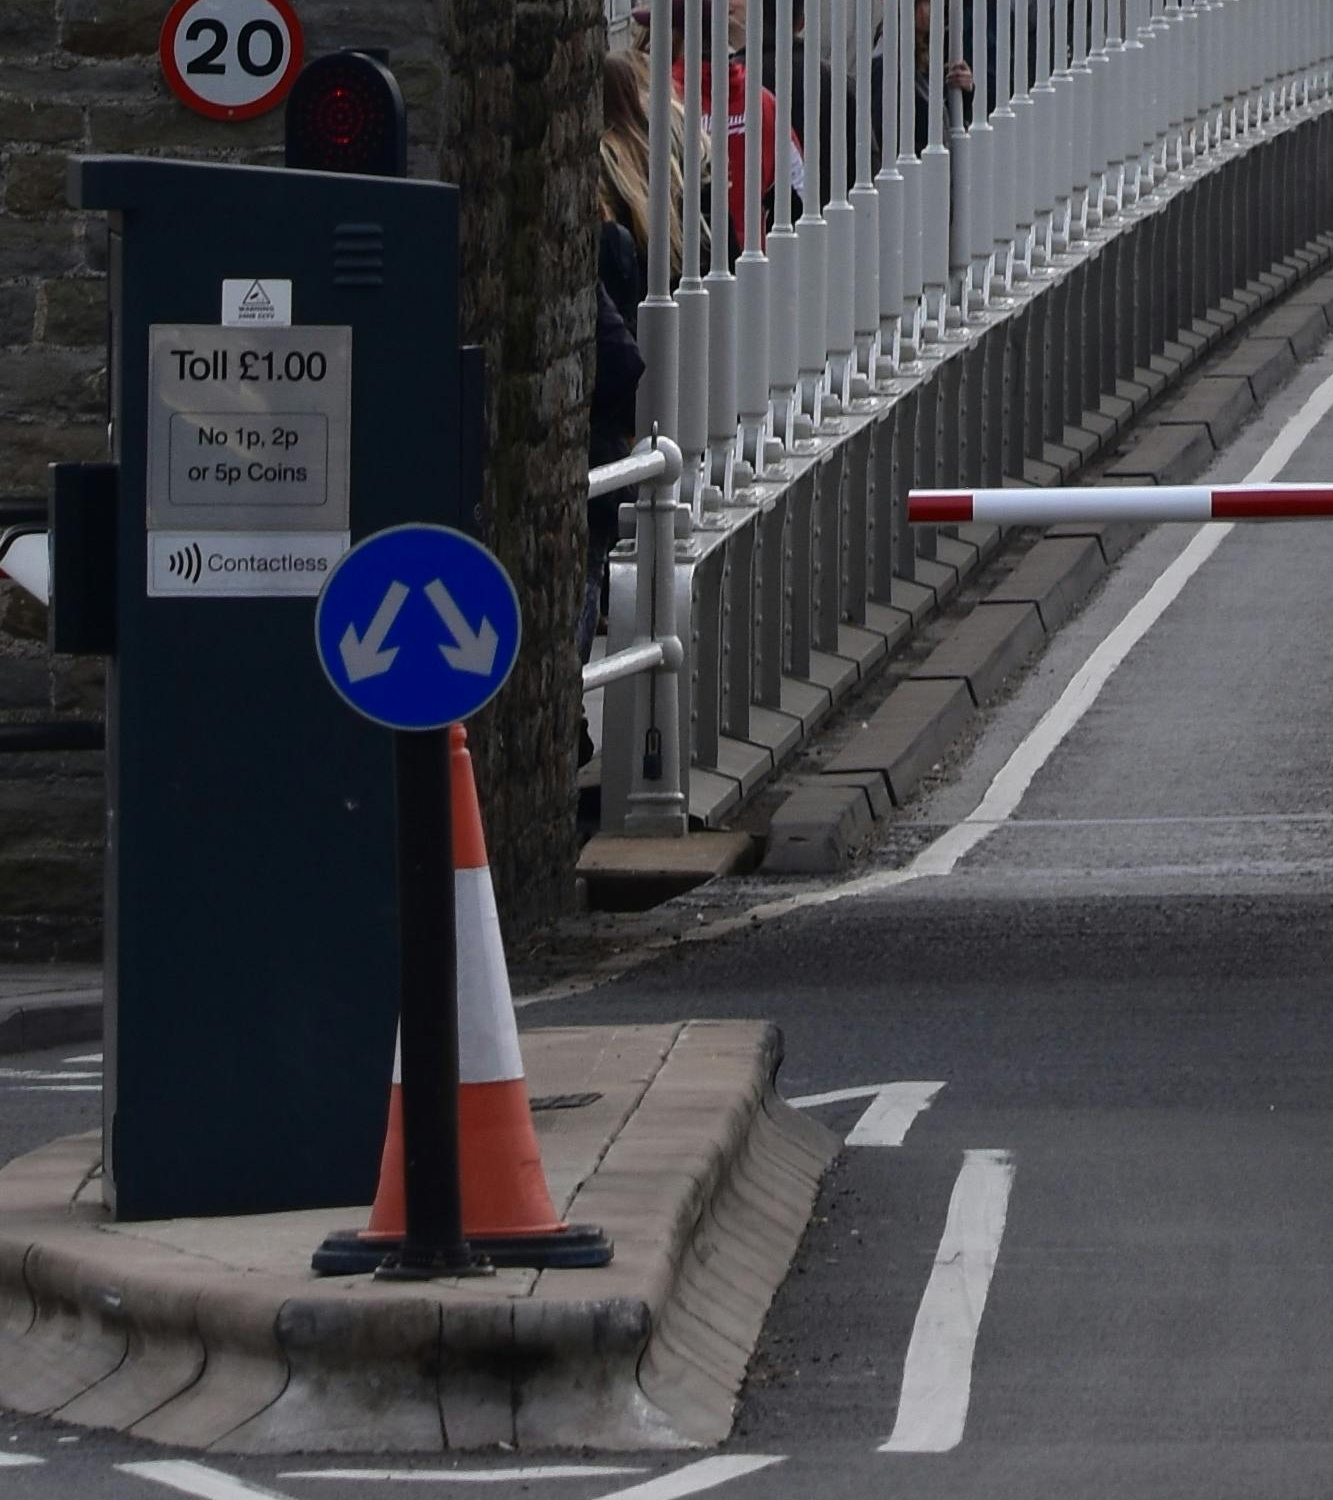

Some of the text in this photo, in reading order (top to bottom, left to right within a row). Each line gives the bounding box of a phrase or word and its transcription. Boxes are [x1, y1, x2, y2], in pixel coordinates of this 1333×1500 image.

[185, 18, 284, 77] 20
[171, 350, 327, 382] Toll £1.00
[198, 427, 299, 451] No 1p, 2p
[188, 463, 308, 486] or 5p Coins
[207, 553, 328, 572] Contactless
